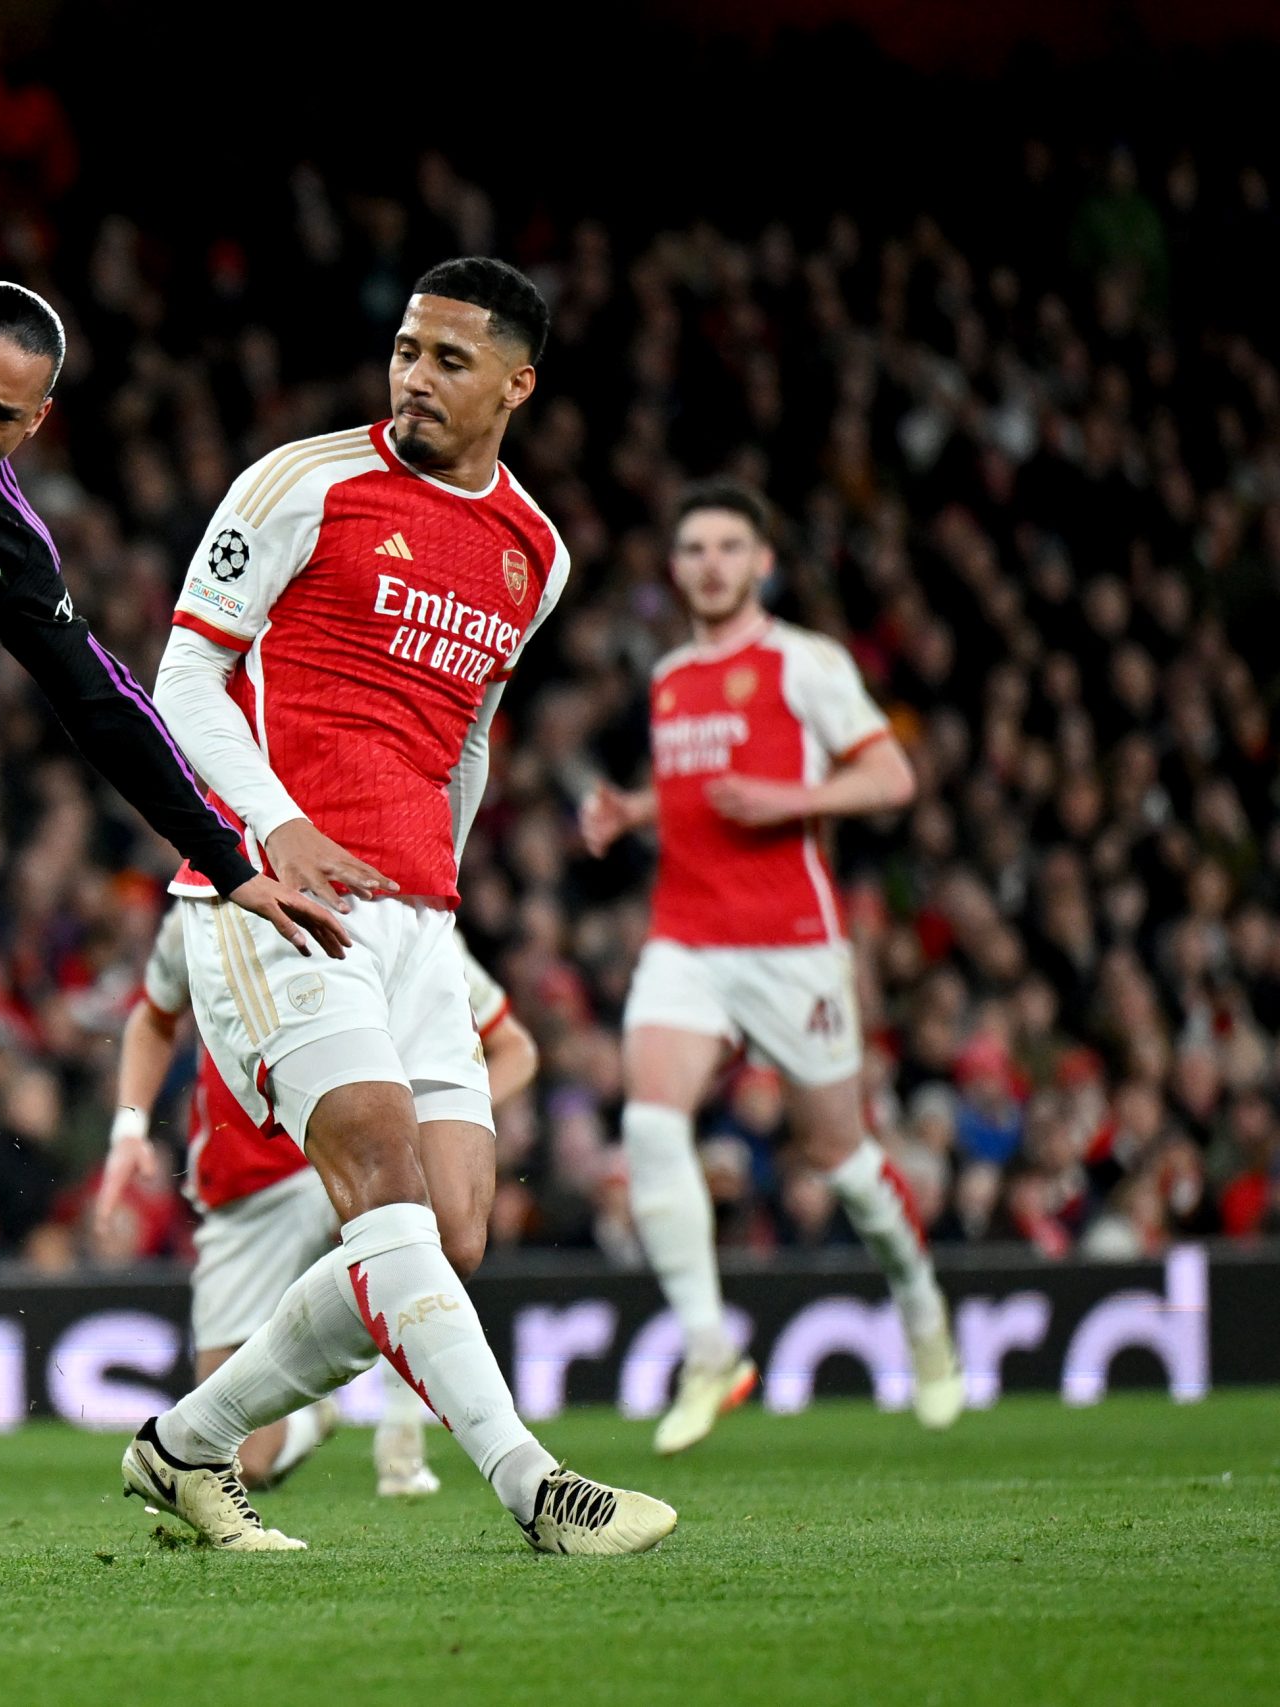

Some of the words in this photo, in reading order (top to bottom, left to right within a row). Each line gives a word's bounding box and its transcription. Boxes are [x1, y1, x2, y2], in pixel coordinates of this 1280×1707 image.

[189, 582, 244, 613] FOUNDATION
[374, 574, 520, 658] Emirates
[388, 625, 431, 662] FLY
[430, 636, 496, 685] BETTER
[397, 1293, 460, 1336] AFC
